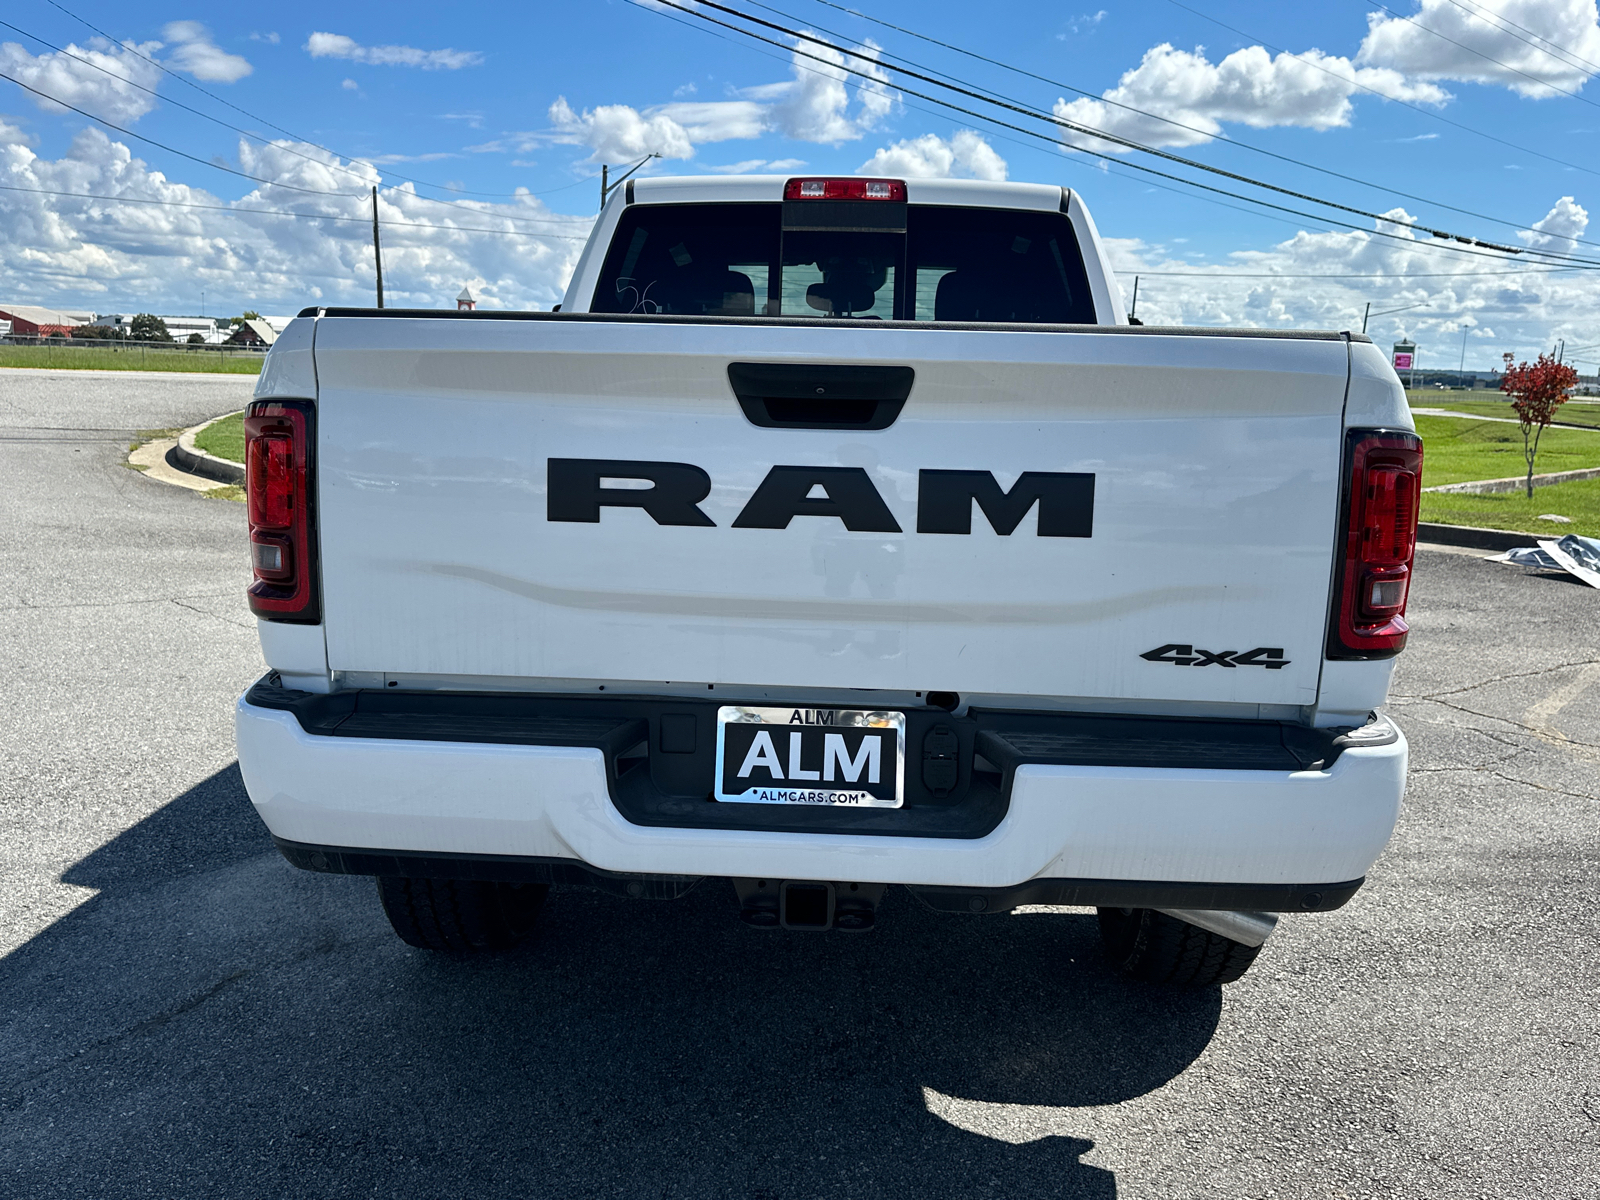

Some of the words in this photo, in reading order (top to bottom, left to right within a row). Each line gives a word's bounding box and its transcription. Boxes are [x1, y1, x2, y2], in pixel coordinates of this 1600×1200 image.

[616, 276, 658, 314] 56
[547, 457, 1096, 538] RAM
[1139, 643, 1292, 669] 4x4
[788, 709, 834, 725] ALM
[736, 730, 882, 784] ALM
[759, 790, 859, 804] ALMCARS.COM
